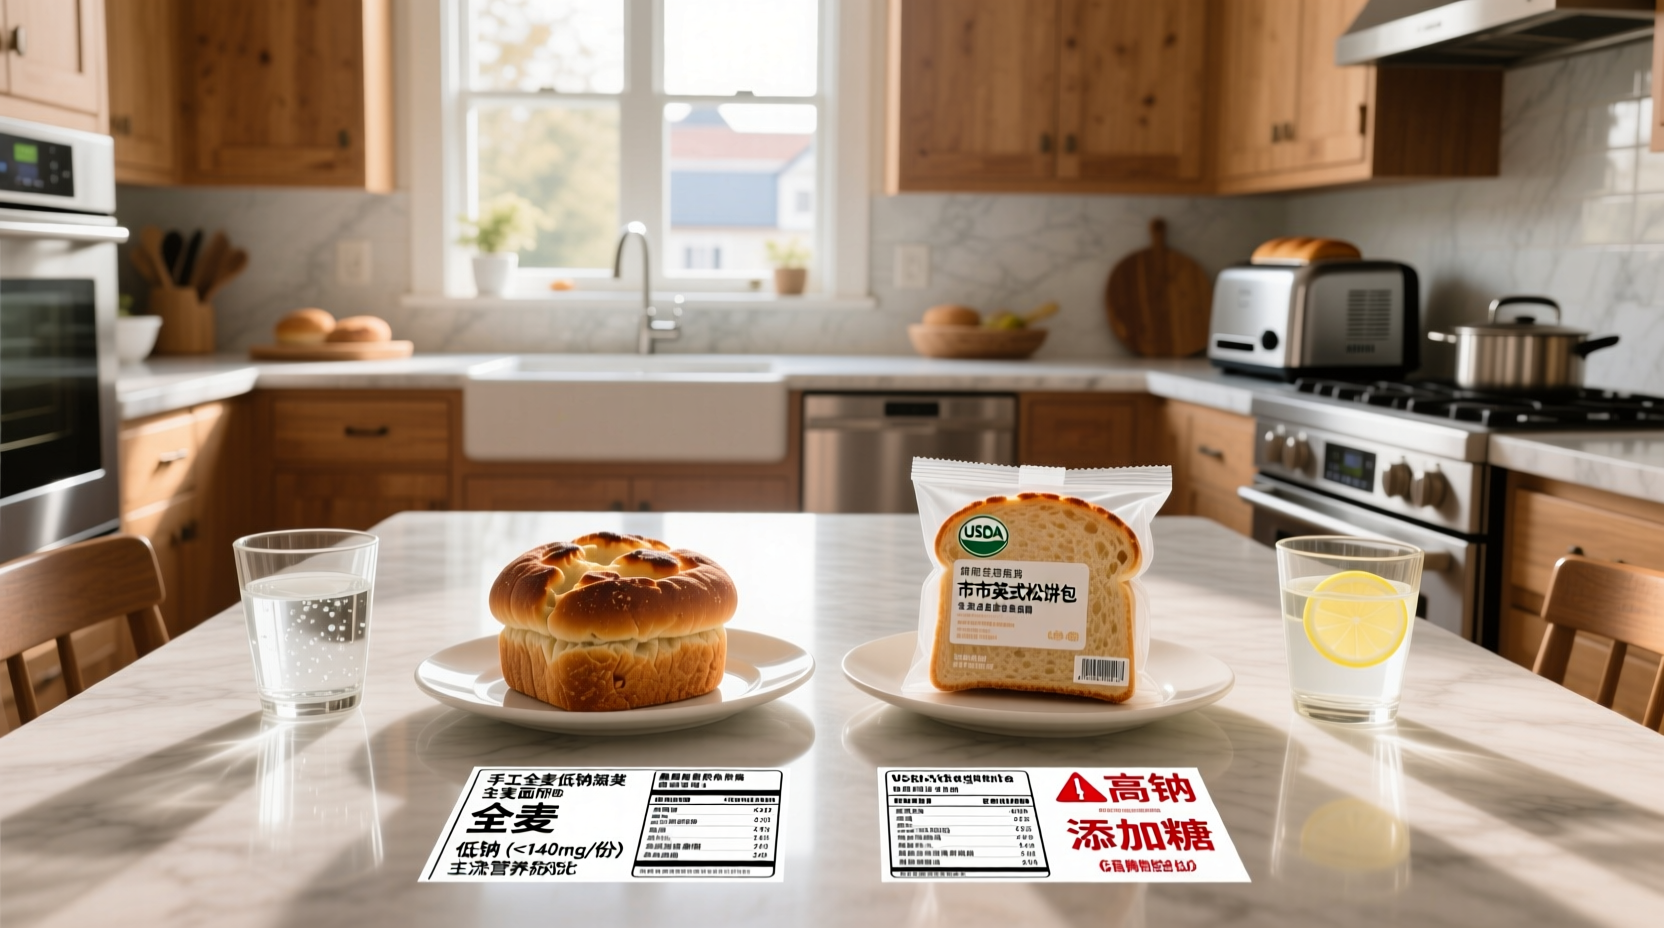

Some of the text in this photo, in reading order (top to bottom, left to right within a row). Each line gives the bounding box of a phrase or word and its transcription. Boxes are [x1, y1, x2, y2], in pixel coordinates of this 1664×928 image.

[964, 525, 1004, 541] USDA
[1103, 772, 1197, 803] 高钠
[466, 802, 560, 834] 全麦
[1066, 818, 1216, 852] 添加糖
